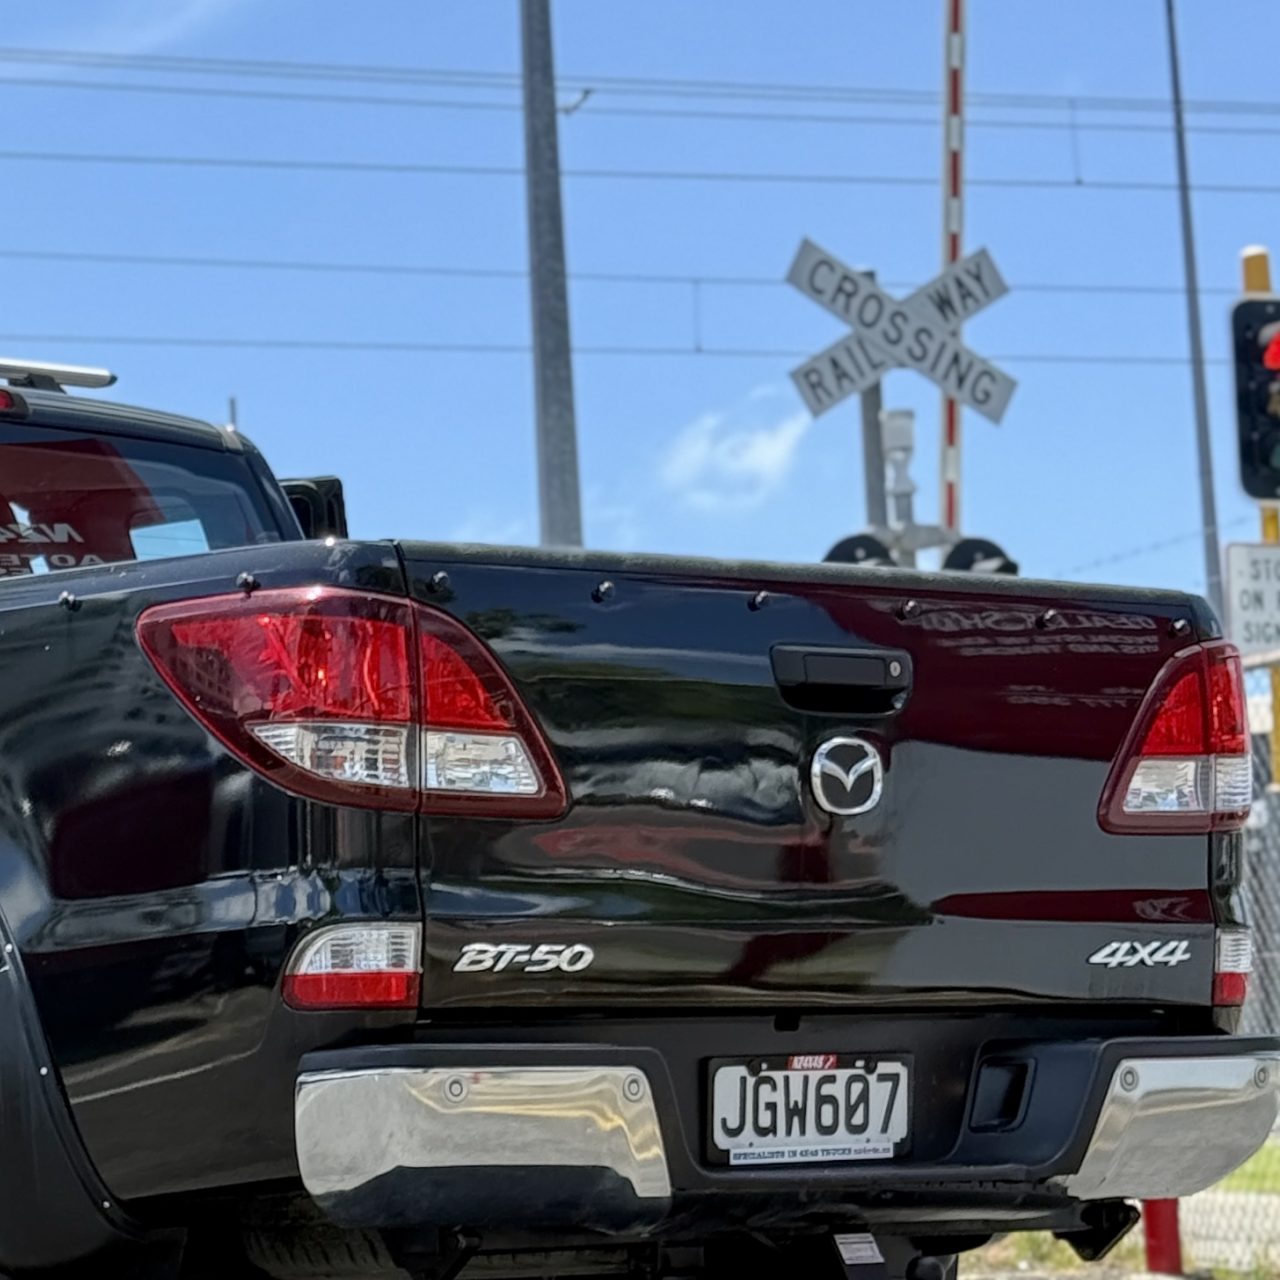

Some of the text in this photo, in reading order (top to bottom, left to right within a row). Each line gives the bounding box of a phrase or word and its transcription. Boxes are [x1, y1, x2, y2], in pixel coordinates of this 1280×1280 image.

[803, 262, 992, 405] RAIL WAY
[808, 260, 997, 405] CROSSING
[1239, 588, 1264, 611] ON
[453, 943, 595, 973] BT-50
[1087, 940, 1192, 968] 4X4
[721, 1072, 901, 1138] JGW607
